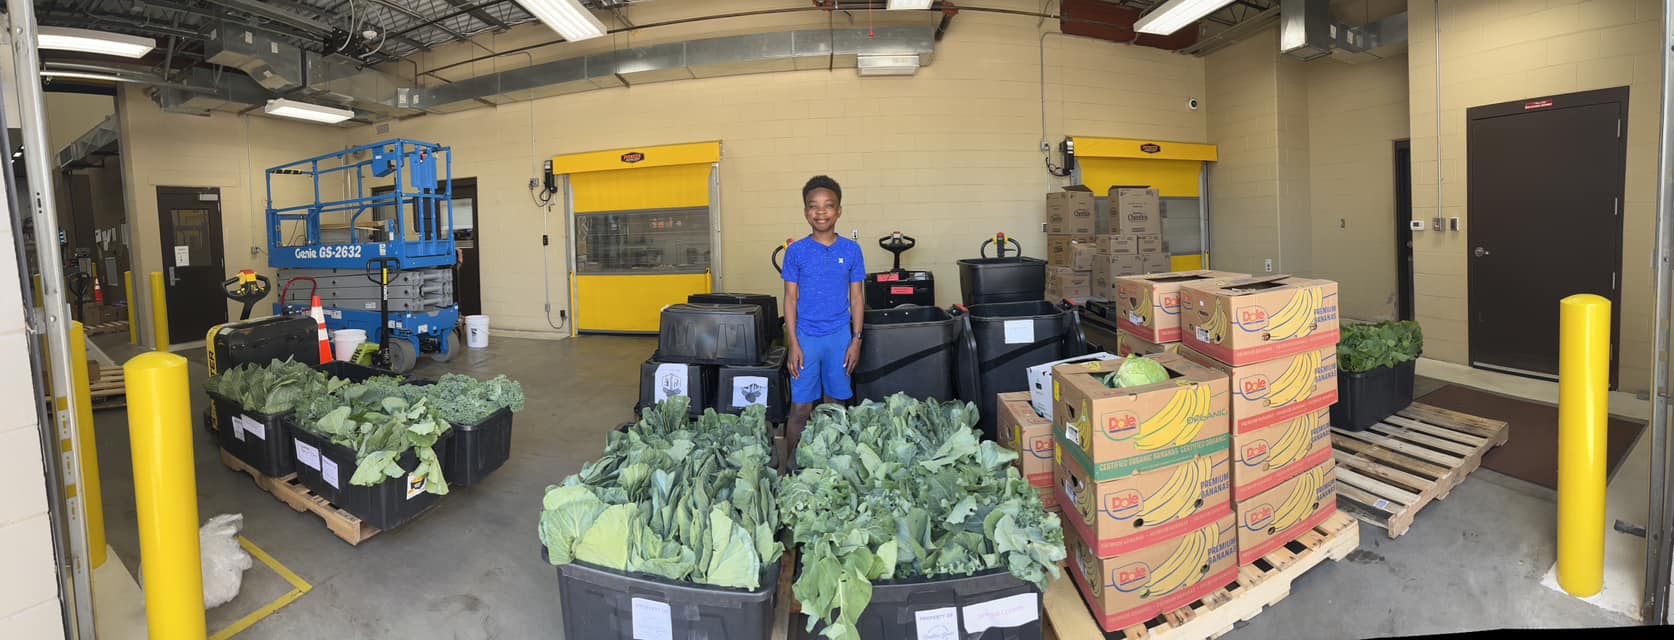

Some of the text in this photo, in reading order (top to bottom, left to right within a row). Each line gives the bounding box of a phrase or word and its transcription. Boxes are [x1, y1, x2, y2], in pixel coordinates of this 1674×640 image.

[295, 245, 362, 259] Genie GS-2632
[1242, 310, 1265, 322] Dole
[1244, 378, 1266, 393] Dole
[1108, 415, 1136, 430] Dole
[1035, 439, 1054, 450] Dol
[1247, 442, 1267, 458] Dole
[1201, 472, 1229, 489] PREMIUM
[1112, 493, 1139, 509] Dole
[1250, 507, 1271, 523] Dole
[1208, 537, 1236, 556] PREMIUM
[1120, 567, 1145, 583] Dole
